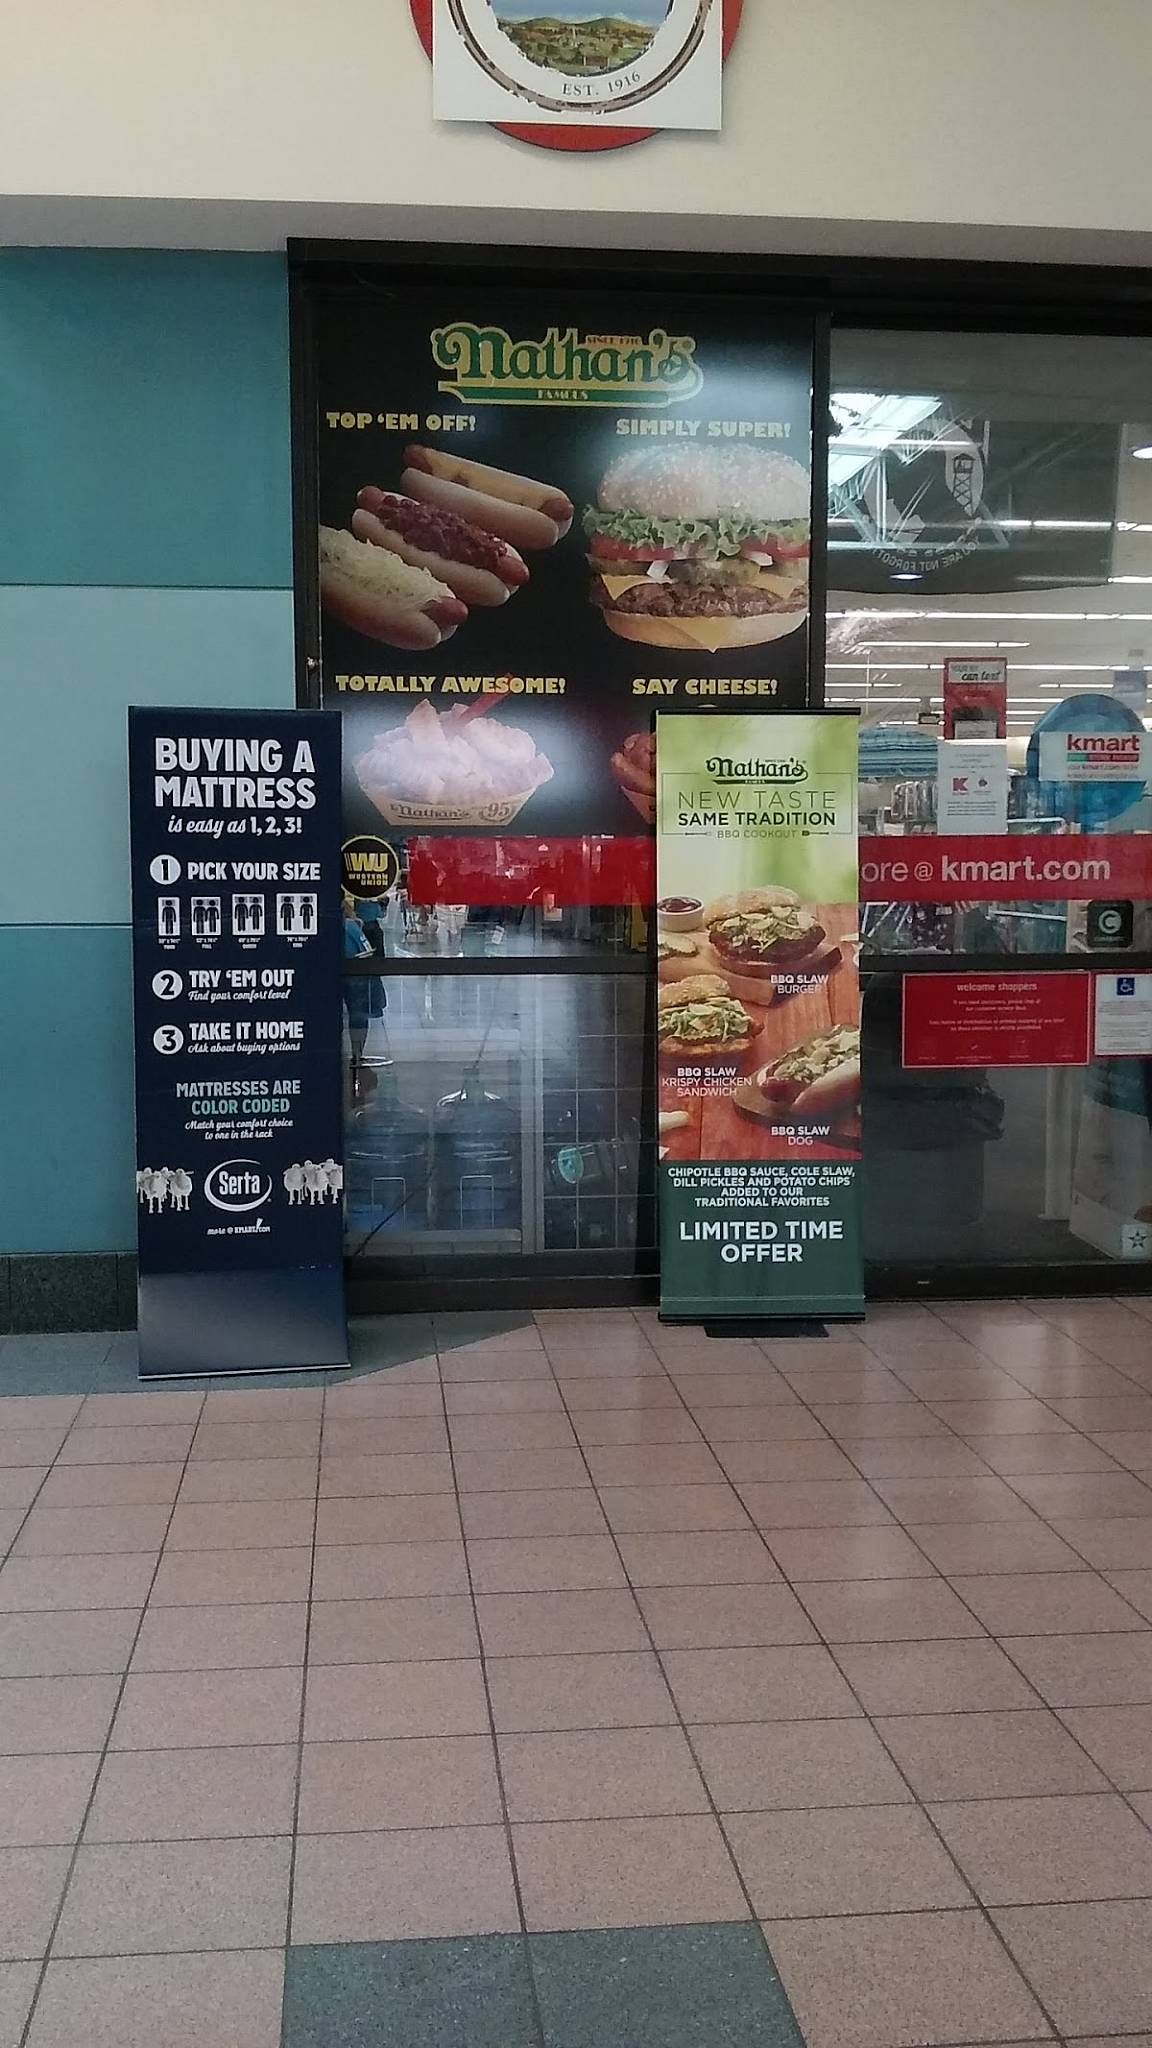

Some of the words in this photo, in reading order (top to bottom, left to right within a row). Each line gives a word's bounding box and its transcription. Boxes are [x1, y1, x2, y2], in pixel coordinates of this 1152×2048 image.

[562, 82, 599, 96] EST.
[607, 71, 641, 93] 1916
[433, 325, 698, 384] Nathan's
[326, 412, 372, 429] TOP
[426, 414, 477, 431] OFF!
[616, 418, 700, 436] SIMPLY
[707, 421, 792, 438] SUPER!
[335, 675, 434, 693] TOTALLY
[442, 676, 566, 694] AWESOME!
[632, 679, 680, 695] SAY
[684, 679, 778, 696] CHEESE!
[1067, 734, 1140, 751] kmart
[155, 737, 283, 772] BUYING
[292, 740, 316, 773] A
[705, 756, 807, 778] Nathan's
[155, 775, 317, 809] MATTRESS
[678, 791, 741, 809] NEW
[754, 791, 836, 809] TASTE
[390, 803, 470, 819] Nathan's
[678, 812, 729, 826] SAME
[735, 812, 836, 826] TRADITION
[168, 815, 182, 833] is
[186, 818, 225, 839] easy
[227, 819, 246, 834] as
[717, 829, 740, 838] BBQ
[743, 829, 797, 838] COOKOUT
[161, 859, 170, 881] 1
[187, 862, 227, 881] PICK
[231, 862, 278, 881] YOUR
[283, 862, 321, 881] SIZE
[343, 852, 389, 872] WU
[914, 861, 934, 882] @
[941, 855, 1112, 881] kmart.com
[159, 974, 175, 996] 2
[189, 970, 222, 988] TRY
[261, 969, 295, 987] OUT
[770, 974, 795, 984] BBQ
[797, 974, 829, 984] SLAW
[956, 982, 996, 992] welcome
[997, 981, 1038, 993] shoppers
[188, 990, 209, 1001] Find
[210, 992, 232, 1004] your
[233, 990, 267, 1004] comfort
[267, 989, 291, 1000] level
[777, 984, 822, 994] BURGER
[161, 1030, 177, 1051] 3
[189, 1022, 231, 1040] TAKE
[236, 1022, 251, 1040] IT
[255, 1021, 304, 1040] HOME
[187, 1042, 208, 1054] Ask
[209, 1042, 235, 1053] about
[237, 1042, 267, 1055] buying
[268, 1042, 301, 1054] options
[677, 1067, 702, 1078] BBQ
[704, 1067, 737, 1077] SLAW
[176, 1080, 269, 1098] MATTRESSES
[272, 1080, 301, 1095] ARE
[662, 1077, 701, 1087] KRISPY
[703, 1077, 752, 1087] CHICKEN
[677, 1087, 738, 1097] SANDWICH
[191, 1099, 239, 1115] COLOR
[242, 1098, 290, 1114] CODED
[185, 1119, 215, 1131] Match
[216, 1121, 235, 1132] your
[236, 1118, 267, 1130] comfort
[268, 1118, 294, 1128] choice
[771, 1126, 796, 1136] BBQ
[797, 1126, 830, 1136] SLAW
[204, 1131, 213, 1140] to
[214, 1132, 230, 1140] one
[230, 1130, 239, 1139] in
[240, 1130, 254, 1139] the
[788, 1136, 814, 1146] DOG
[667, 1167, 721, 1177] CHIPOTLE
[723, 1167, 748, 1177] BBQ
[749, 1166, 789, 1178] SAUCE,
[790, 1166, 820, 1176] COLE
[822, 1166, 855, 1178] SLAW,
[218, 1170, 261, 1195] Serta
[673, 1178, 697, 1187] DILL
[700, 1177, 745, 1187] PICKLES
[747, 1177, 772, 1187] AND
[773, 1177, 816, 1187] POTATO
[818, 1176, 851, 1186] CHIPS
[720, 1187, 760, 1197] ADDED
[762, 1187, 778, 1197] TO
[779, 1187, 804, 1197] OUR
[694, 1197, 769, 1207] TRADITIONAL
[771, 1196, 830, 1207] FAVORITES
[679, 1221, 778, 1240] LIMITED
[784, 1221, 844, 1240] TIME
[720, 1243, 804, 1263] OFFER
